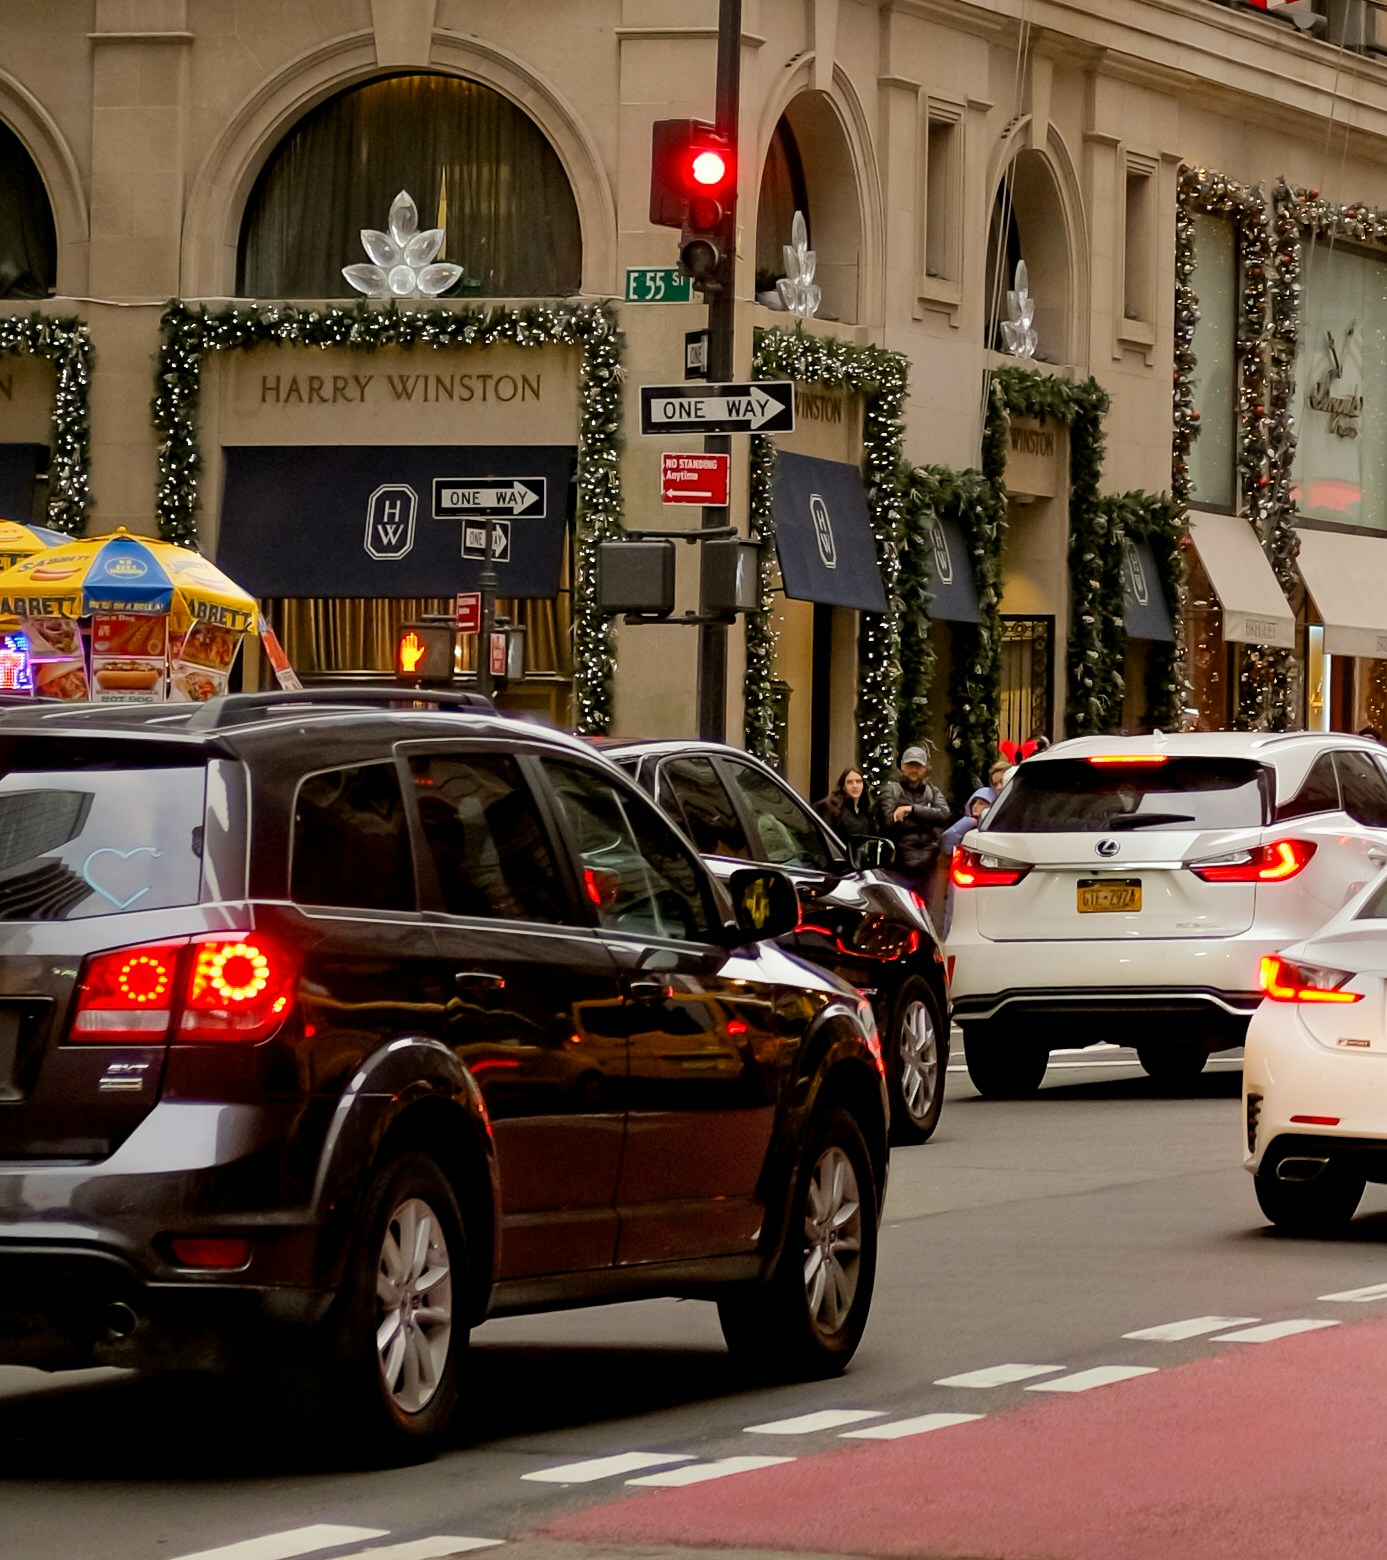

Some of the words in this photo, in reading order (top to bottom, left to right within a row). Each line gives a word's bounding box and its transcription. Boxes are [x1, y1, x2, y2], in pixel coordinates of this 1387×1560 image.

[628, 272, 640, 300] E
[645, 271, 666, 300] 55
[260, 374, 374, 403] HARRY
[384, 373, 543, 403] WINSTON
[663, 400, 706, 420] ONE
[726, 398, 770, 418] WAY
[1010, 429, 1054, 457] WINSTON
[665, 458, 678, 469] NO
[678, 458, 718, 470] STANDING
[665, 469, 699, 481] Anytime
[450, 491, 481, 506] ONE
[495, 491, 528, 506] WAY
[383, 500, 401, 523] H
[376, 524, 405, 547] W
[469, 531, 484, 547] ONE
[493, 534, 503, 548] AY
